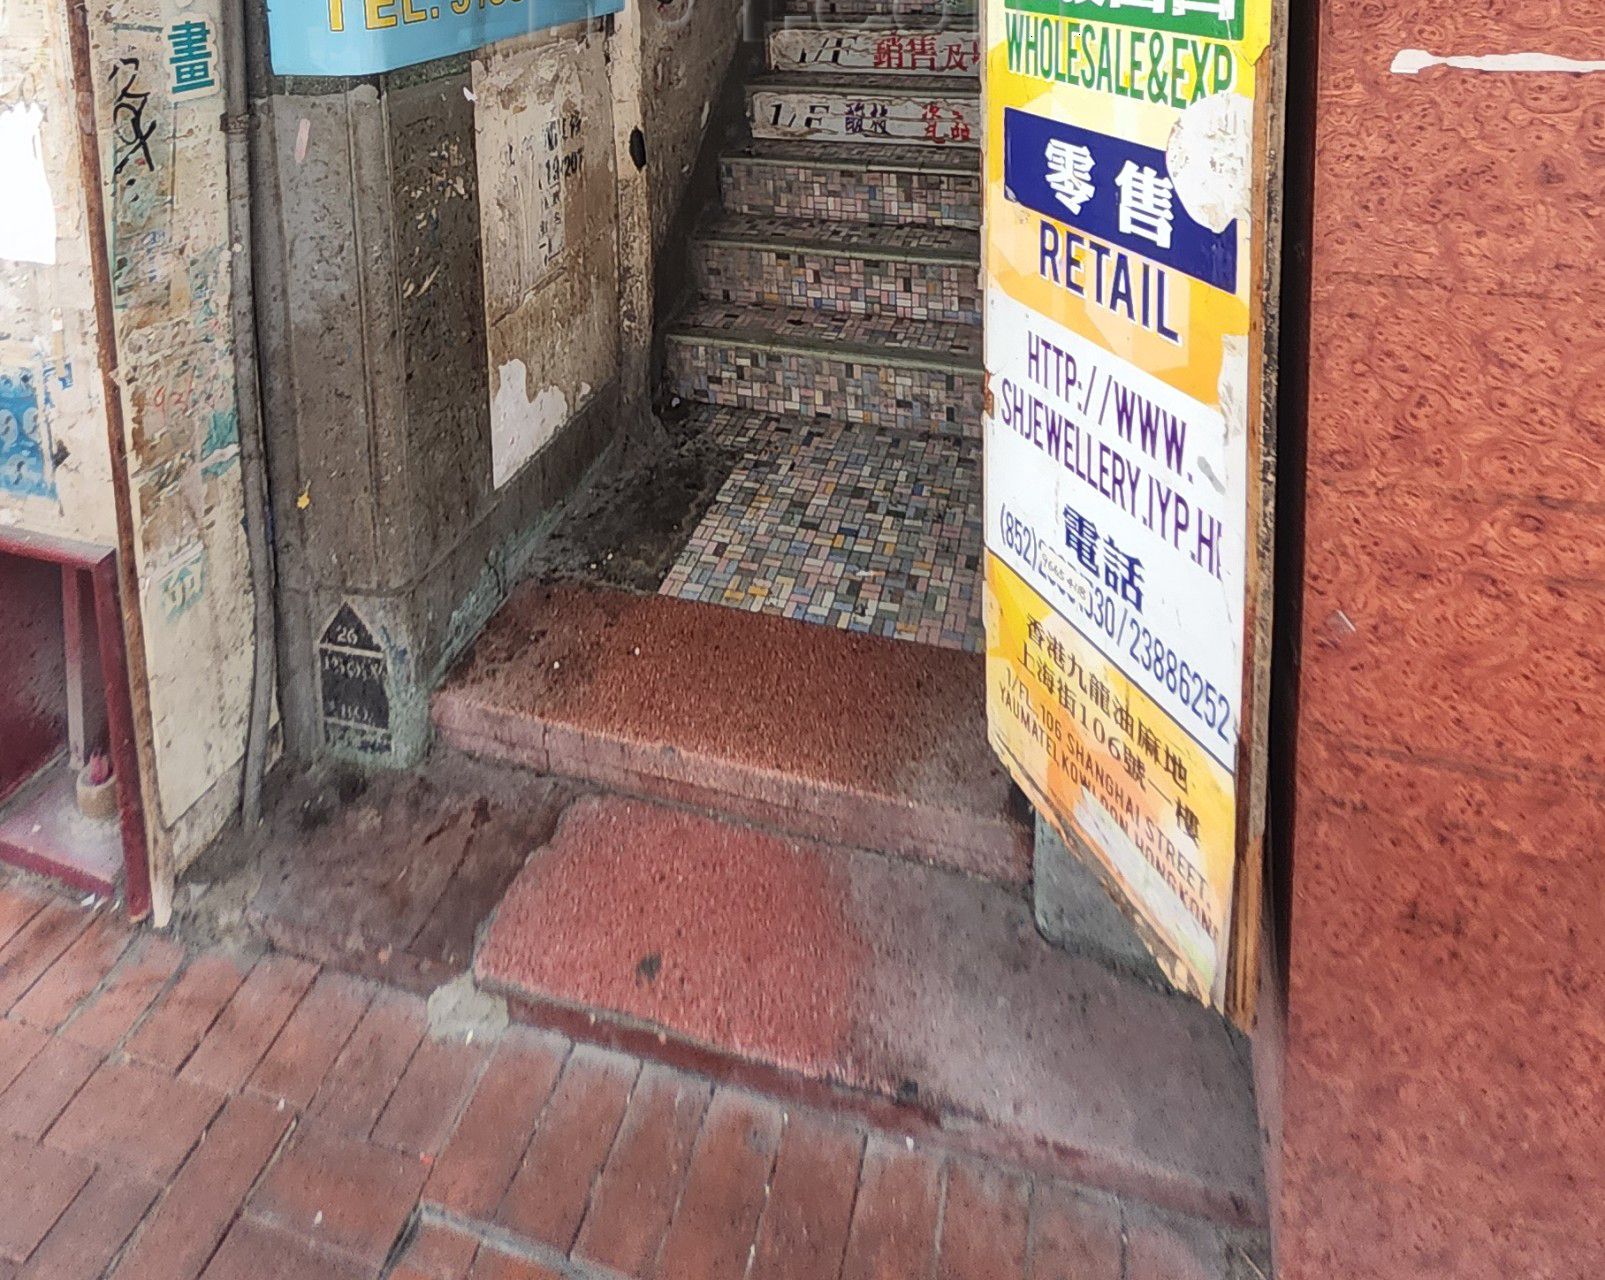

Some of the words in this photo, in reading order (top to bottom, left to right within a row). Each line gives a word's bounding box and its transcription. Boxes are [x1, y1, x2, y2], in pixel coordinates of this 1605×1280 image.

[1044, 137, 1175, 250] 零售
[1039, 219, 1181, 345] RETAIL
[1063, 502, 1146, 615] 電話
[1026, 613, 1188, 792] 香港九龍油麻地
[1067, 732, 1140, 826] SHANGHAI
